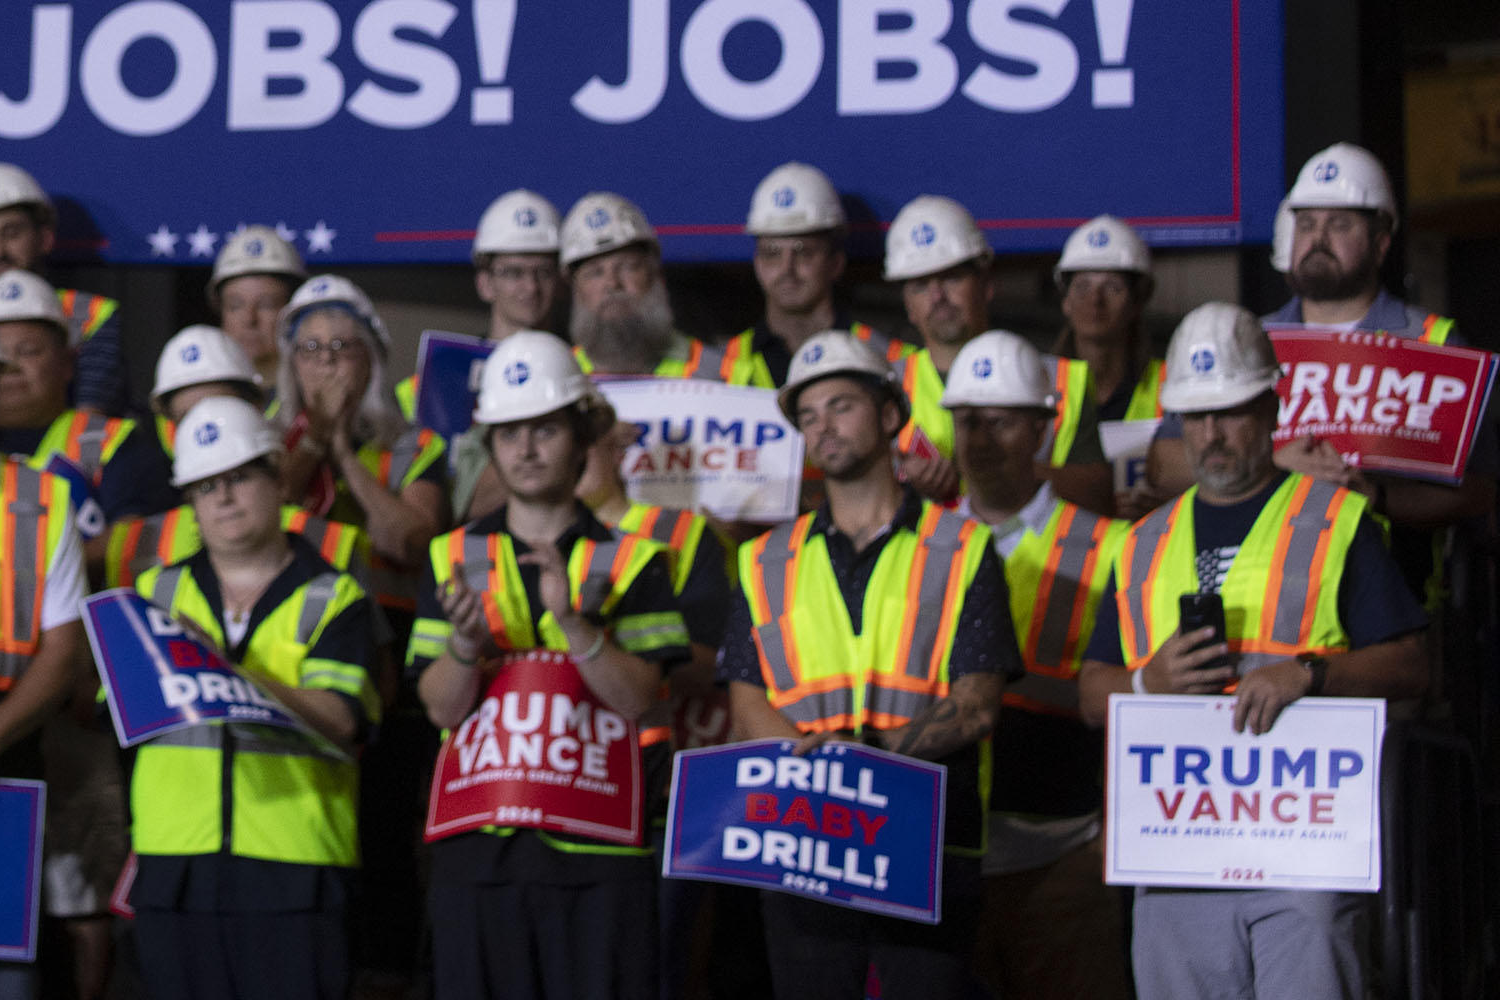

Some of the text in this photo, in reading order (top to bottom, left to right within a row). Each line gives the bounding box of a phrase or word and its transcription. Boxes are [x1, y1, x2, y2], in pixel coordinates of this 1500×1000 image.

[1280, 361, 1467, 408] RUMP
[1277, 393, 1436, 430] VANCE
[616, 448, 758, 475] ANCE
[454, 691, 627, 750] TRUMP
[458, 733, 609, 780] VANCE
[1128, 746, 1365, 788] TRUMP
[735, 756, 889, 808] DRILL
[745, 793, 889, 846] BABY
[1155, 788, 1335, 824] VANCE
[722, 826, 890, 891] DRILL!
[1221, 867, 1265, 881] 2024
